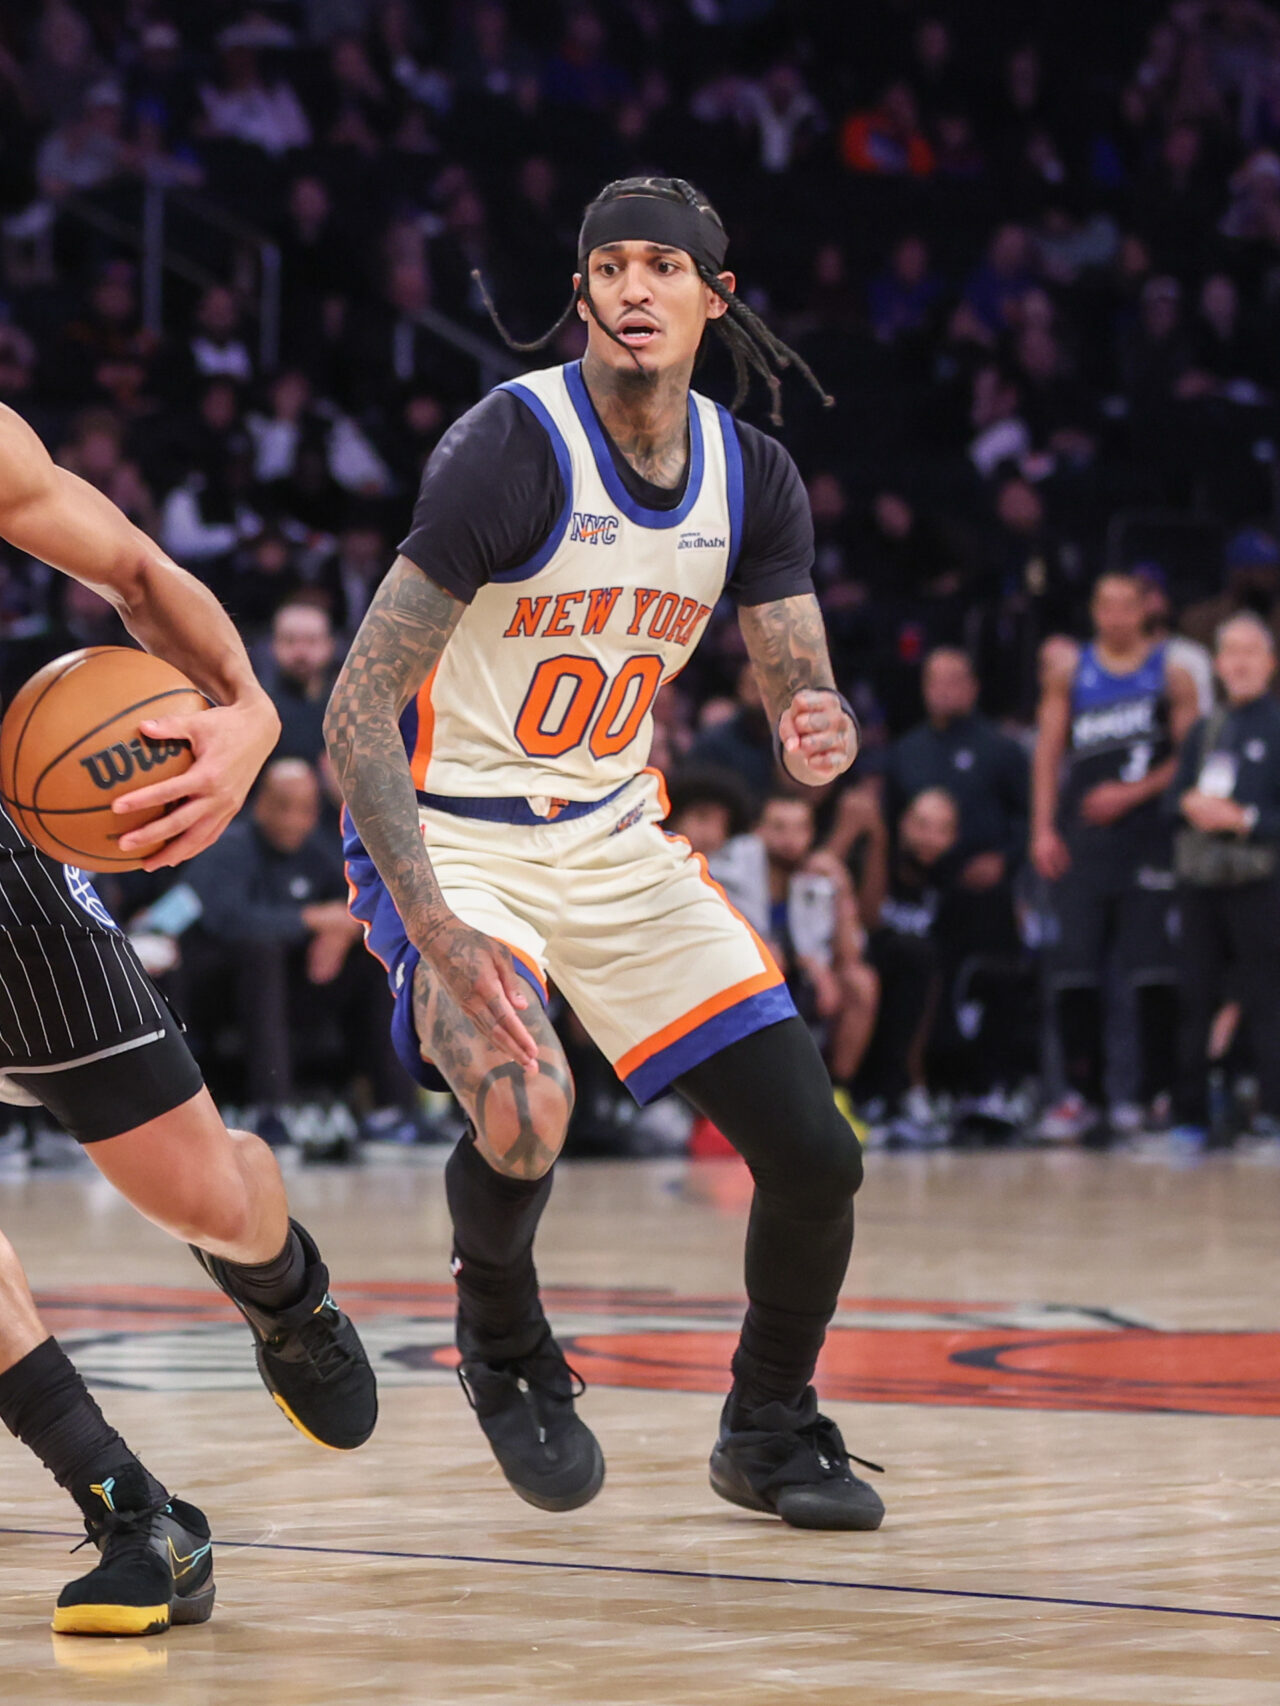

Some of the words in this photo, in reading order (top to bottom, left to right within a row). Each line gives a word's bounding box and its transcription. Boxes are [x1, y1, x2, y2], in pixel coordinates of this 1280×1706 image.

[570, 513, 618, 545] NYC
[503, 587, 624, 638] NEW
[626, 588, 713, 646] YORK
[514, 654, 665, 761] 00
[80, 738, 183, 790] Wils
